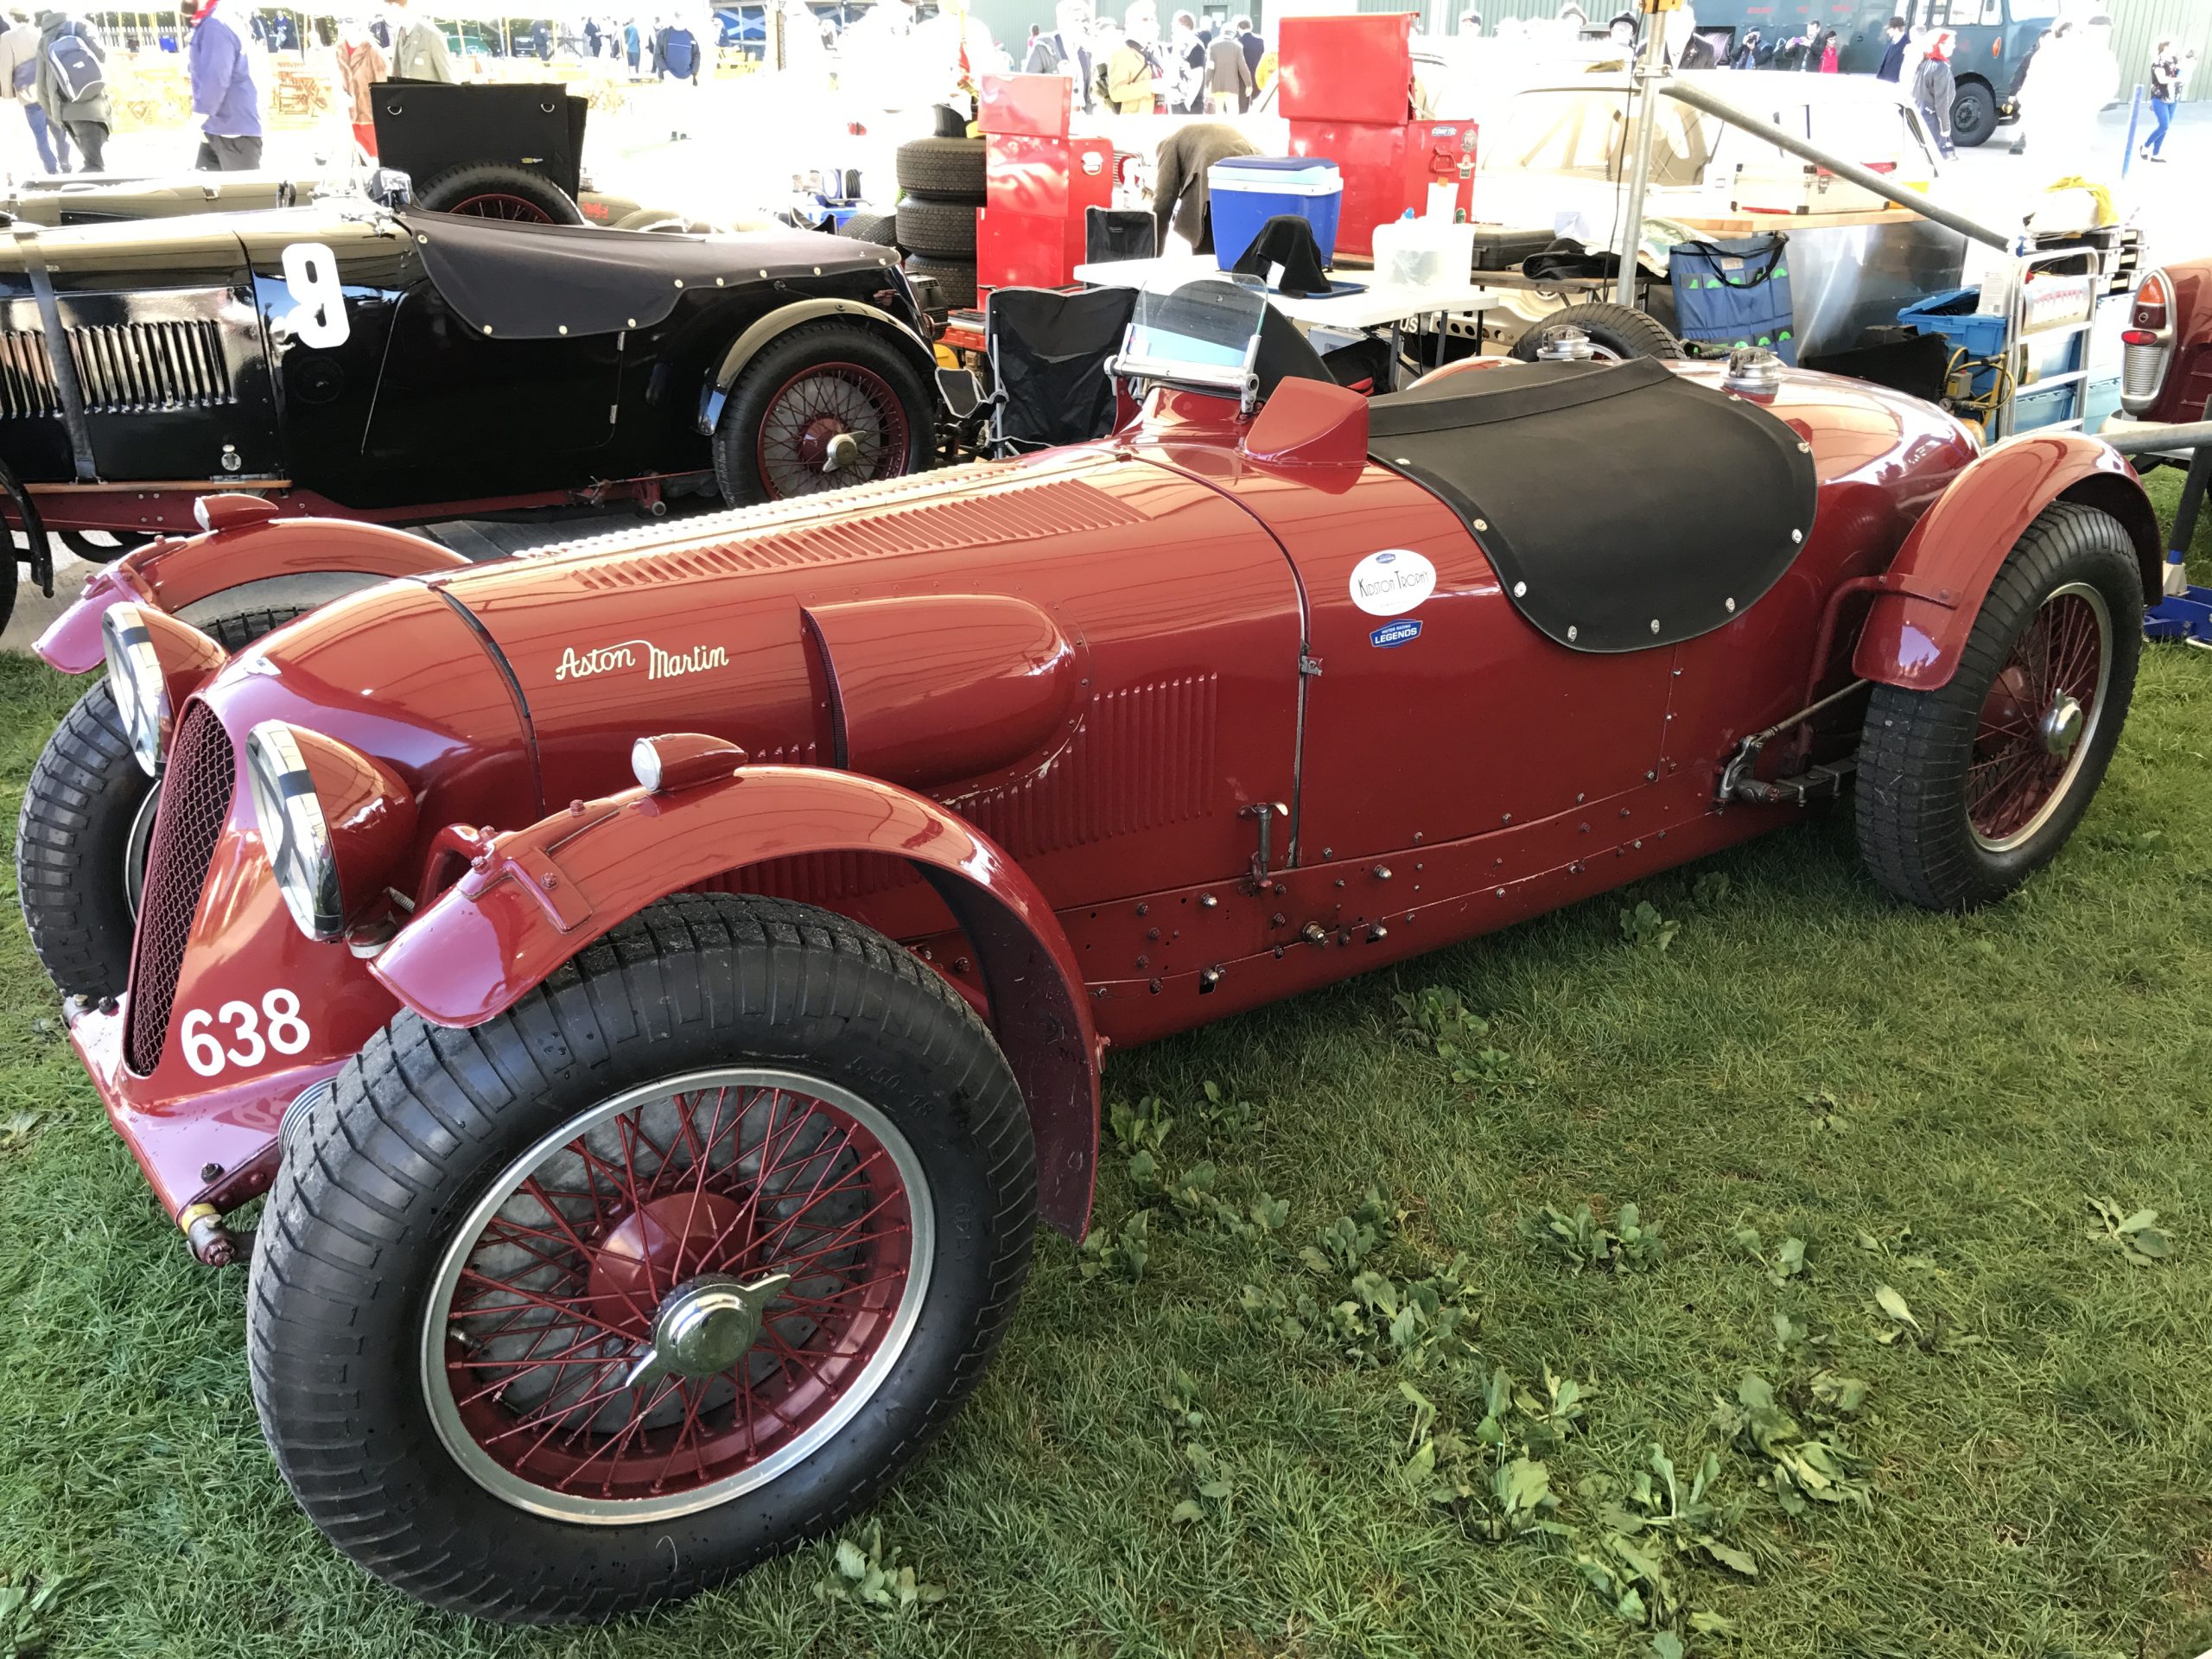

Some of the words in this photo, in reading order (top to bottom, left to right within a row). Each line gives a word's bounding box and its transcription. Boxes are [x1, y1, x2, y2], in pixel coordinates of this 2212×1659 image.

[282, 243, 351, 349] 9
[556, 641, 637, 680] Aston
[648, 645, 729, 680] Martin
[1375, 627, 1417, 645] LEGENDS
[181, 988, 311, 1077] 638
